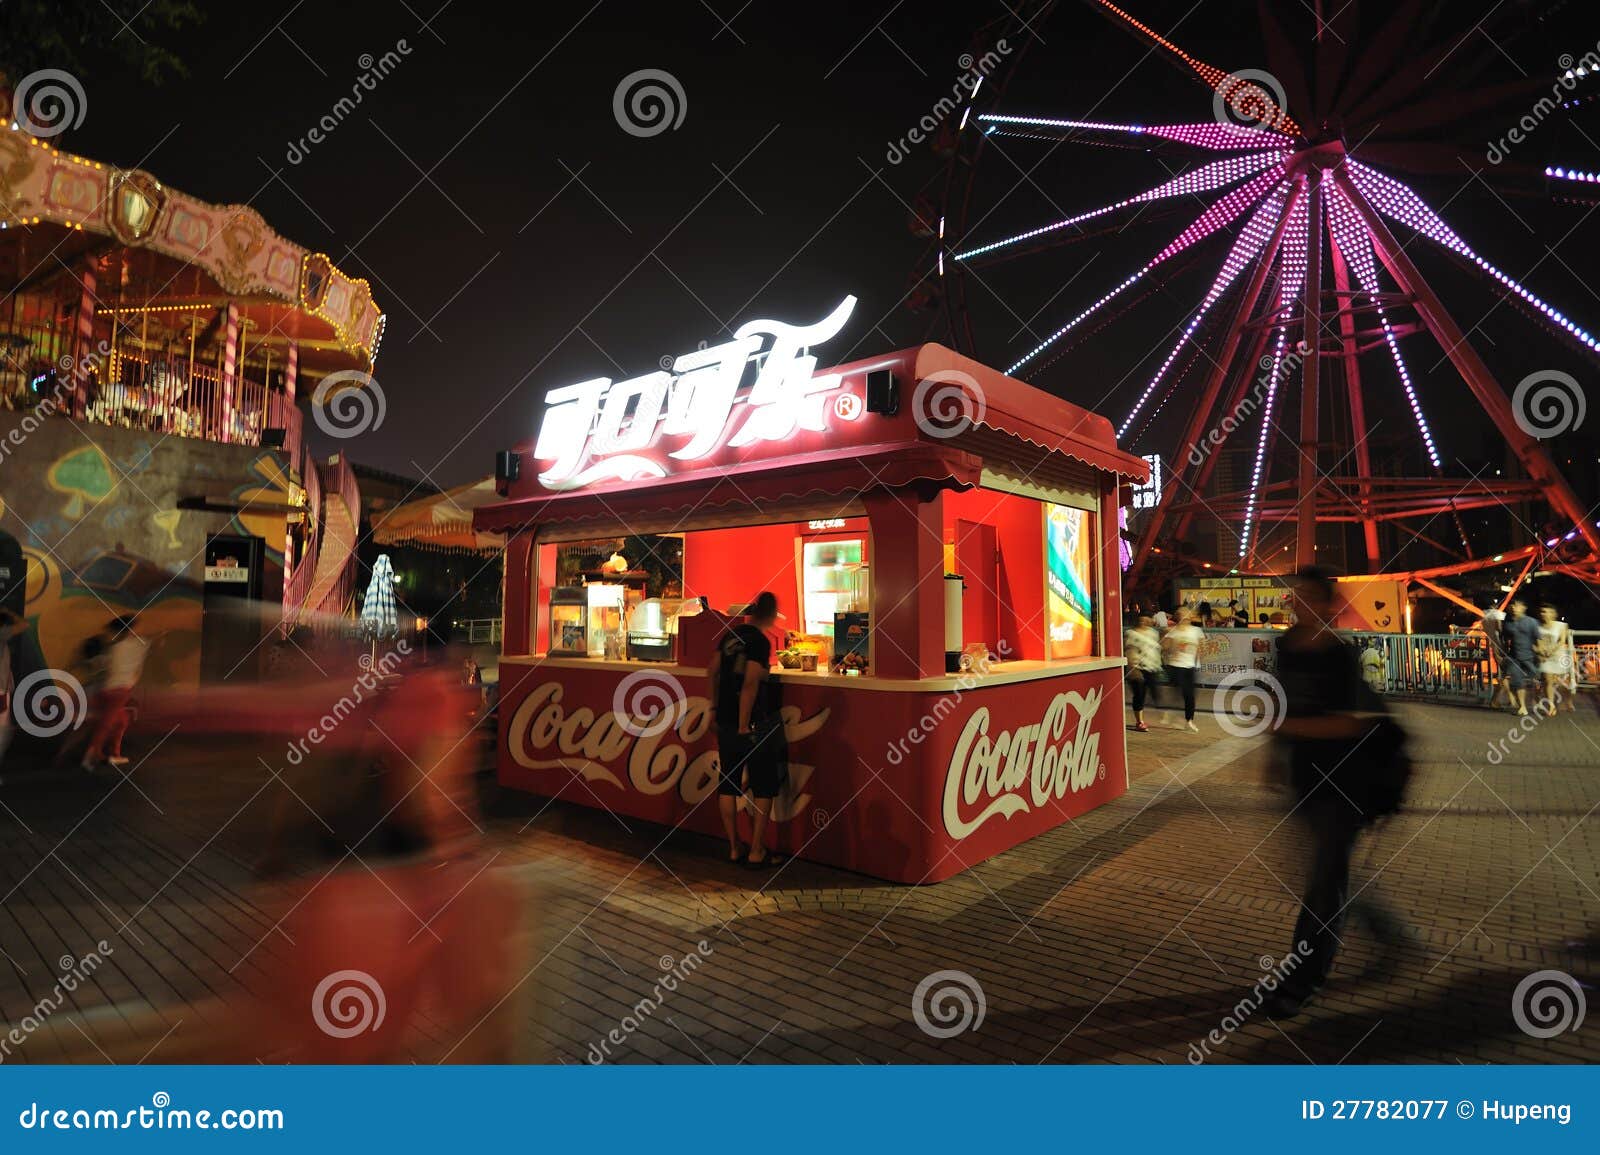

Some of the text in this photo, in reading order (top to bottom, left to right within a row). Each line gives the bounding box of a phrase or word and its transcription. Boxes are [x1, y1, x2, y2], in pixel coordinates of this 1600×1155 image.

[534, 294, 857, 490] 可口可乐
[942, 685, 1103, 840] Coca-Cola
